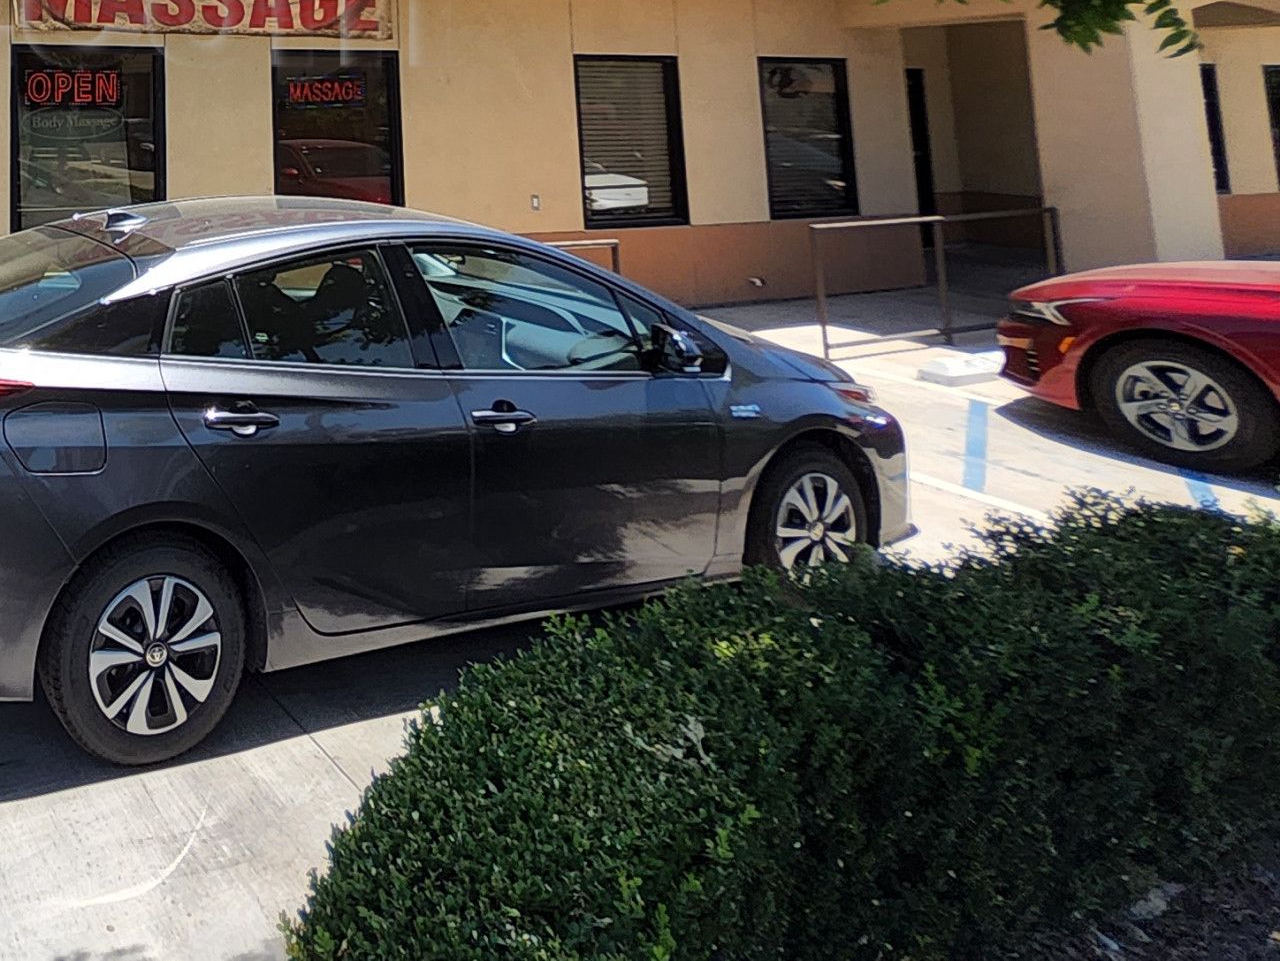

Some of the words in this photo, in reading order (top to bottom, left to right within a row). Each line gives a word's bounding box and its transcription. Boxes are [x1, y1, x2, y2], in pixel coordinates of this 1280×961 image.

[27, 72, 117, 103] OPEN
[288, 79, 364, 103] MASSAGE
[32, 116, 64, 133] Body
[66, 113, 116, 130] Massage
